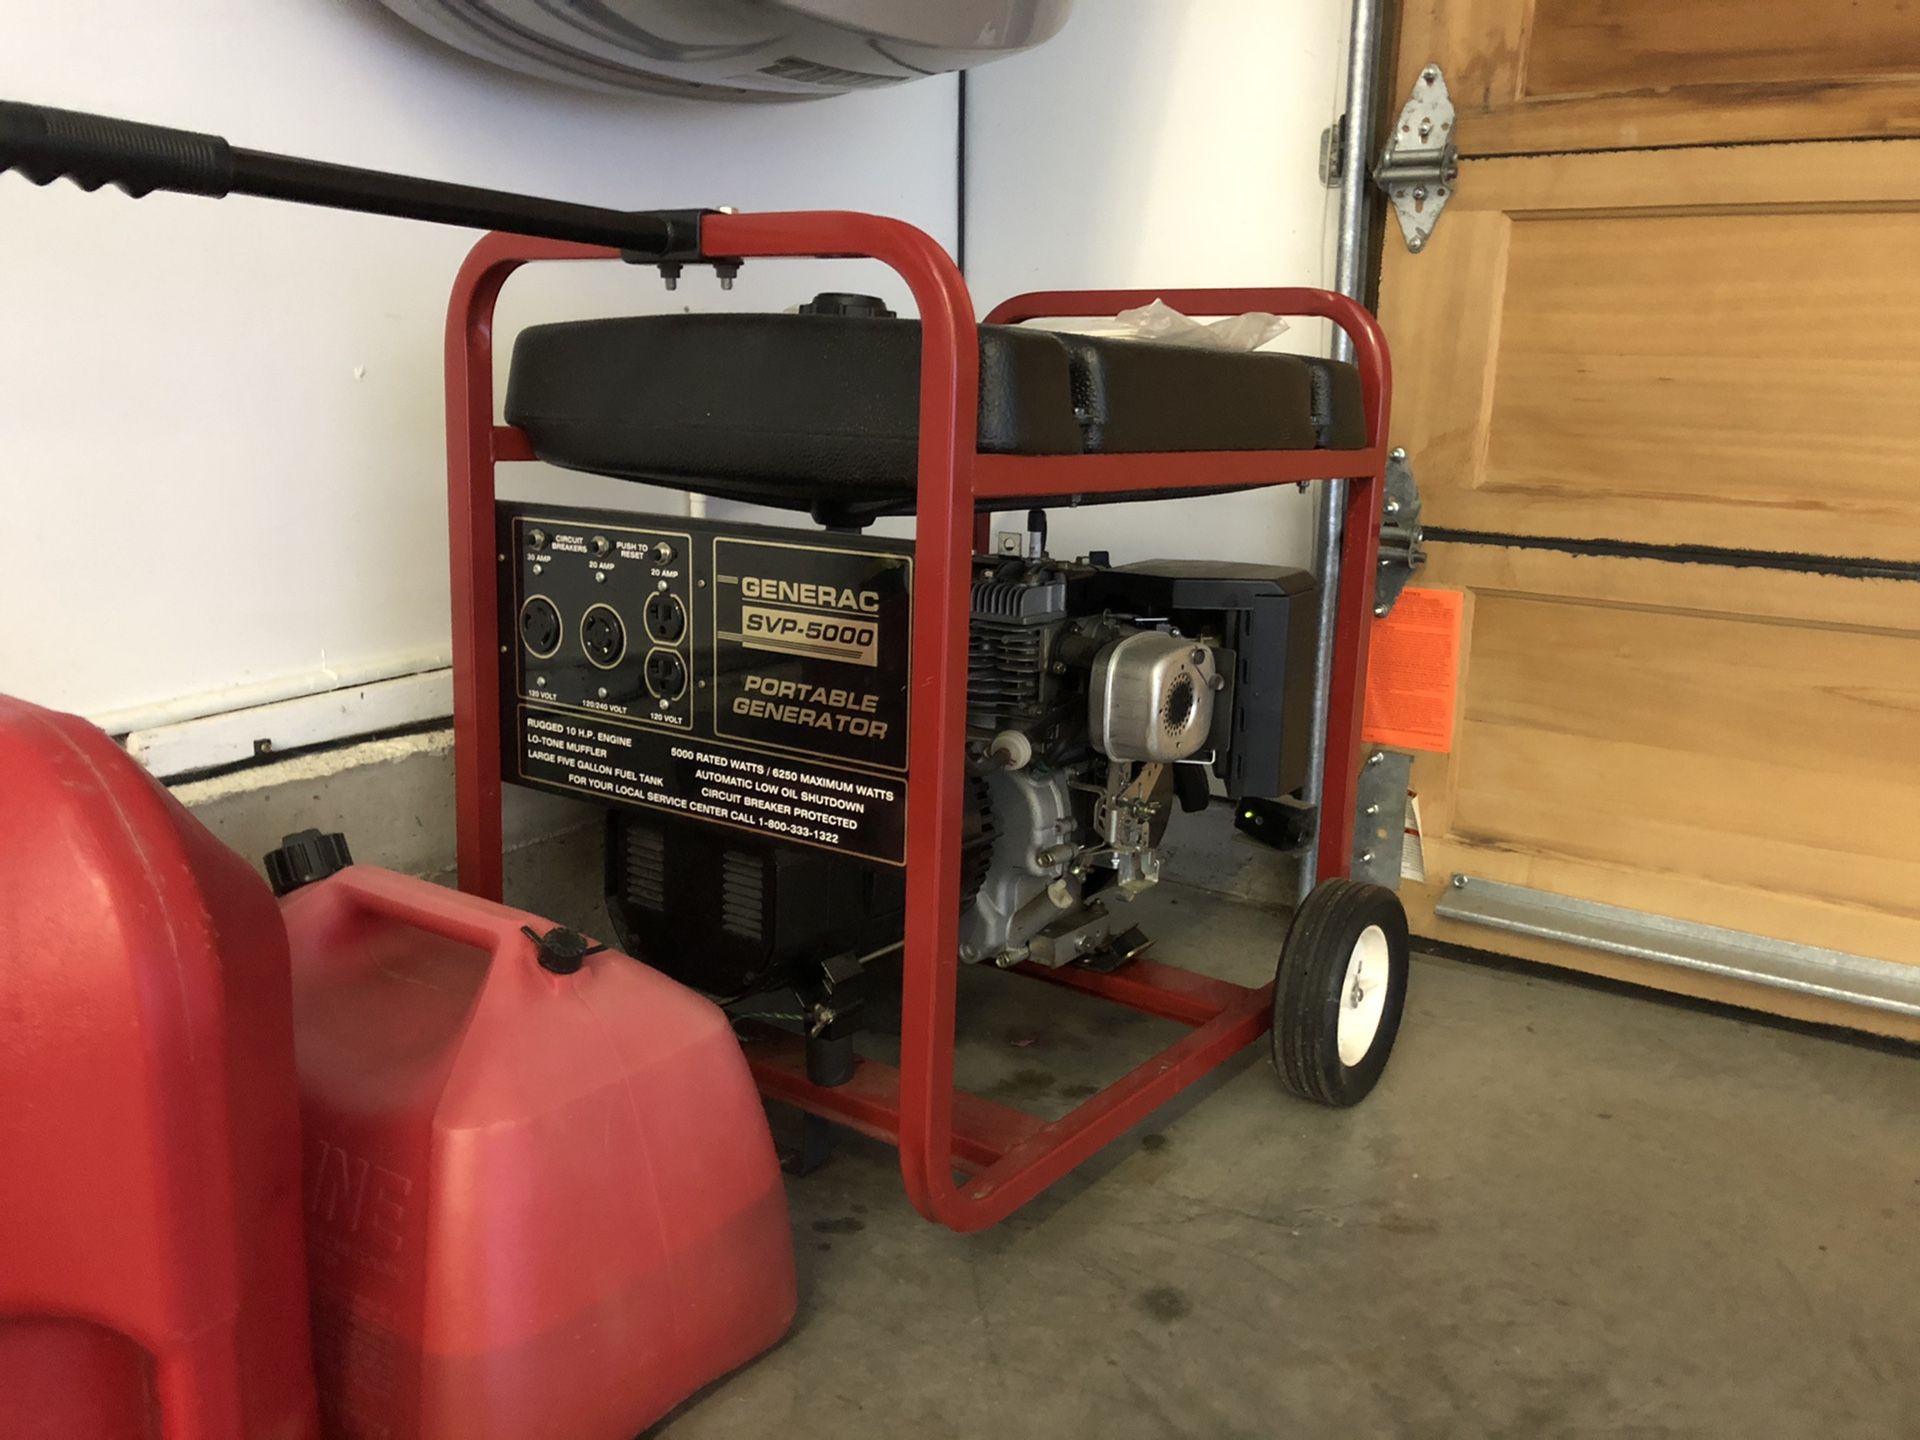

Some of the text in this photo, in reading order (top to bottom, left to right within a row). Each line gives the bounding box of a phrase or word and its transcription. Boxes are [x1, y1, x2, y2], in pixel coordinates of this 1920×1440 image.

[552, 542, 588, 553] BREAKERS
[555, 534, 583, 544] CIRCUIT
[616, 542, 648, 552] PUSH TO
[537, 554, 551, 563] AMP
[599, 562, 615, 570] AMP
[621, 550, 644, 560] RESET
[651, 568, 678, 578] 20 AMP
[741, 576, 880, 613] GENERAC
[746, 613, 874, 647] SVP-5000
[528, 689, 557, 701] 120 VOLT
[582, 699, 627, 714] 120/240 VOLT
[743, 675, 880, 714] PORTABLE
[650, 712, 682, 725] 120 VOLT
[732, 697, 888, 740] GENERATOR
[527, 718, 632, 747] RUGGED 10 H.P. ENGINE
[527, 733, 607, 758] LO-TONE MUFFLER
[528, 749, 664, 787] LARGE FIVE GALLON FUEL TANK
[670, 747, 694, 761] 5000
[696, 752, 728, 767] RATED
[730, 759, 765, 775] WATTS
[772, 768, 798, 782] 6250
[800, 774, 853, 793] MAXIMUM
[855, 785, 894, 802] WATTS
[695, 769, 865, 814] AUTOMATIC LOW OIL SHUTDOWN
[568, 774, 839, 844] FOR YOUR LOCAL SERVICE CENTER CALL 1-800-333-1322
[701, 787, 858, 830] CIRCUIT BREAKER PROTECTED
